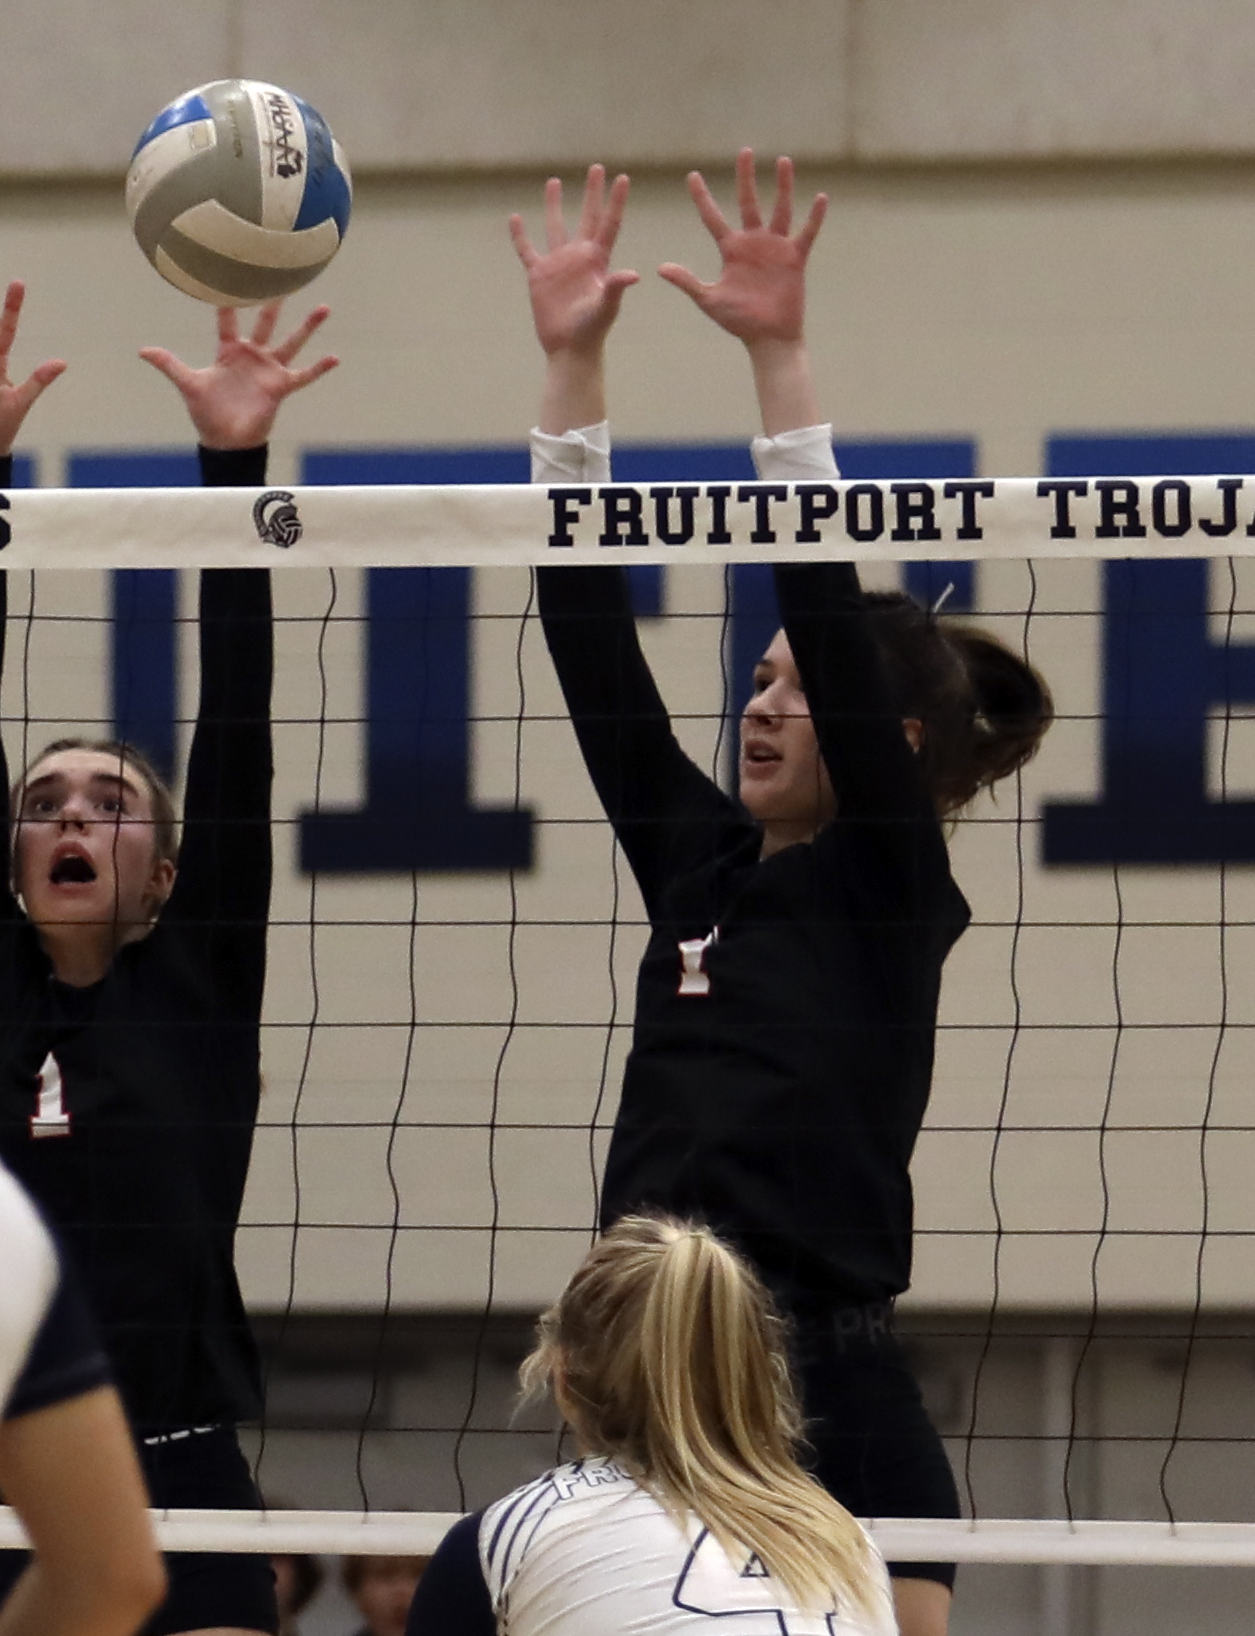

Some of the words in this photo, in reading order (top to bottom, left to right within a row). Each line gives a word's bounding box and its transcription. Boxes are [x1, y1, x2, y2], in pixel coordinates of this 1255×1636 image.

[546, 479, 996, 548] FRUITPORT
[1036, 477, 1255, 539] TROJ
[28, 1050, 73, 1139] 1
[672, 1524, 839, 1636] 4
